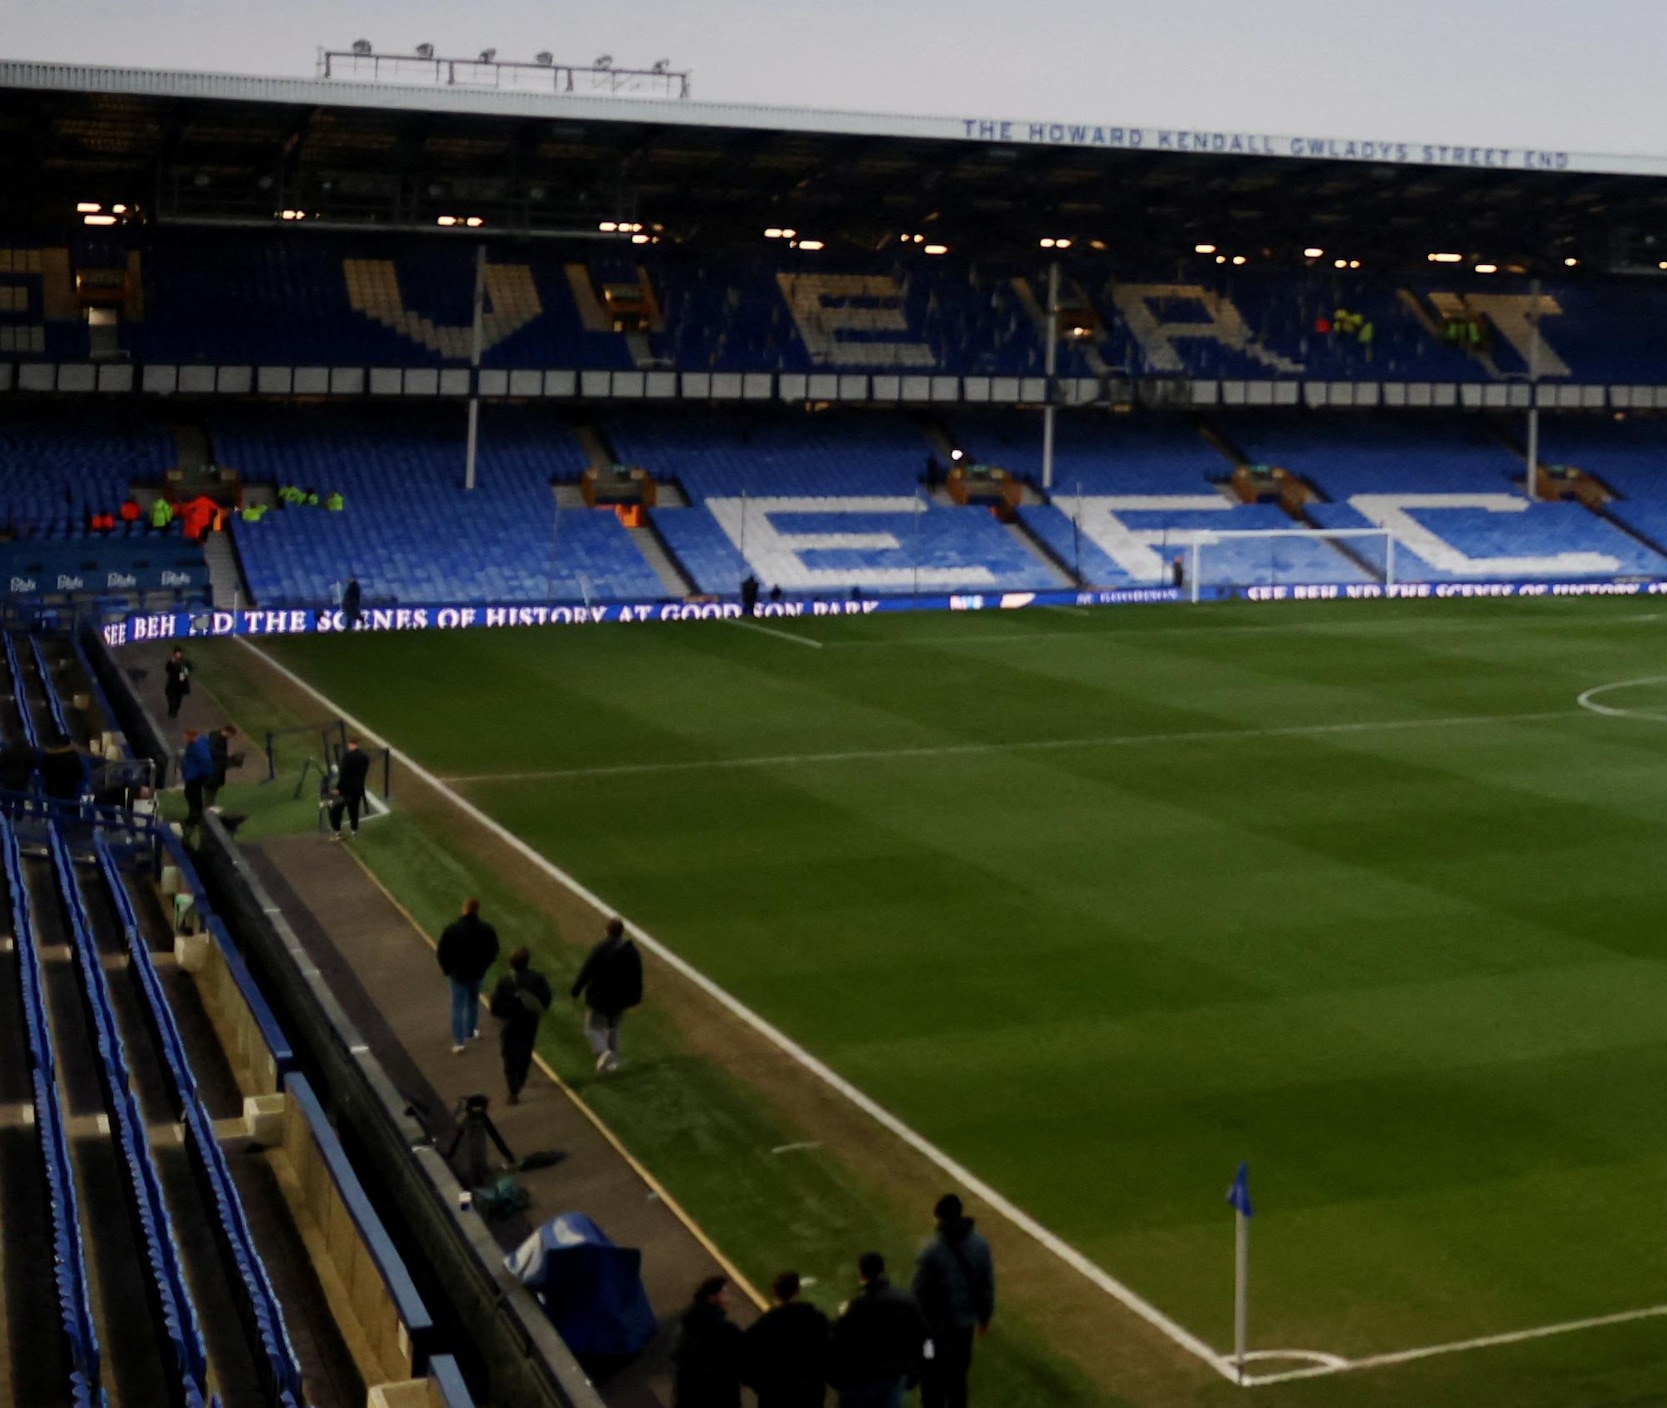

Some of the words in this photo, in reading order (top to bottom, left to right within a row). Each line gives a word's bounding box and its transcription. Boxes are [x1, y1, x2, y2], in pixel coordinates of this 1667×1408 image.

[963, 119, 1012, 140] THE
[1029, 123, 1143, 147] HOWARD
[1158, 130, 1275, 154] KENDALL
[1290, 138, 1407, 162] GWLADYS
[1423, 144, 1508, 167] STREET
[1524, 150, 1569, 170] END
[704, 493, 1622, 586] EFC
[103, 622, 127, 647] SEE
[244, 610, 306, 635] THE
[660, 601, 803, 622] GOODSON
